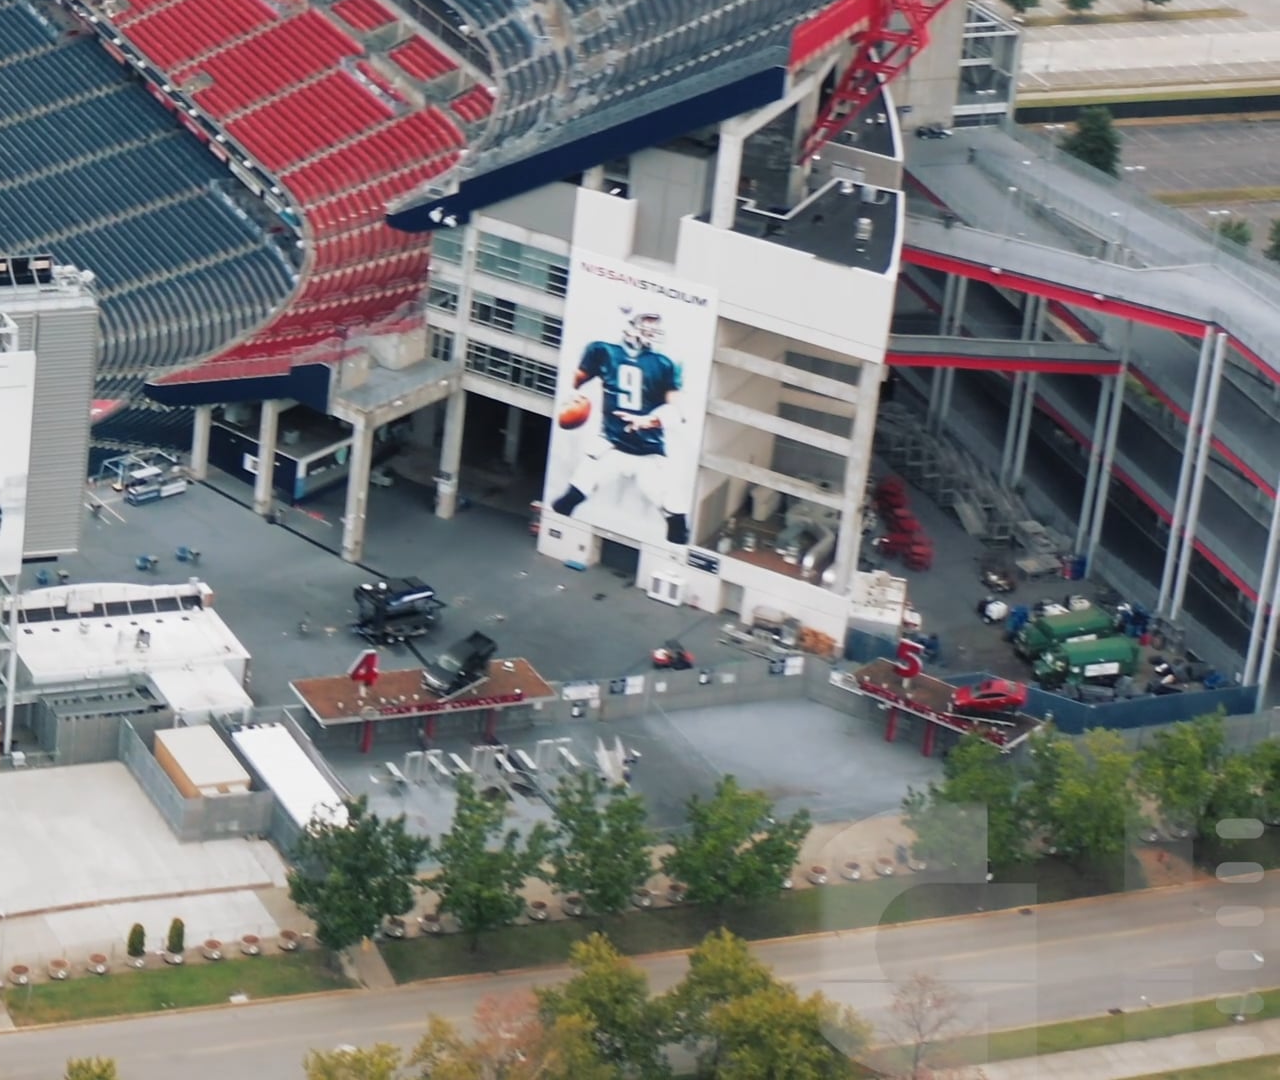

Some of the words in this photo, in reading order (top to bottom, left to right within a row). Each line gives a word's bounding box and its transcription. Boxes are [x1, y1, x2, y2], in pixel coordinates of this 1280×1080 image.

[616, 363, 643, 412] 9
[349, 649, 380, 687] 4
[896, 637, 925, 678] 5
